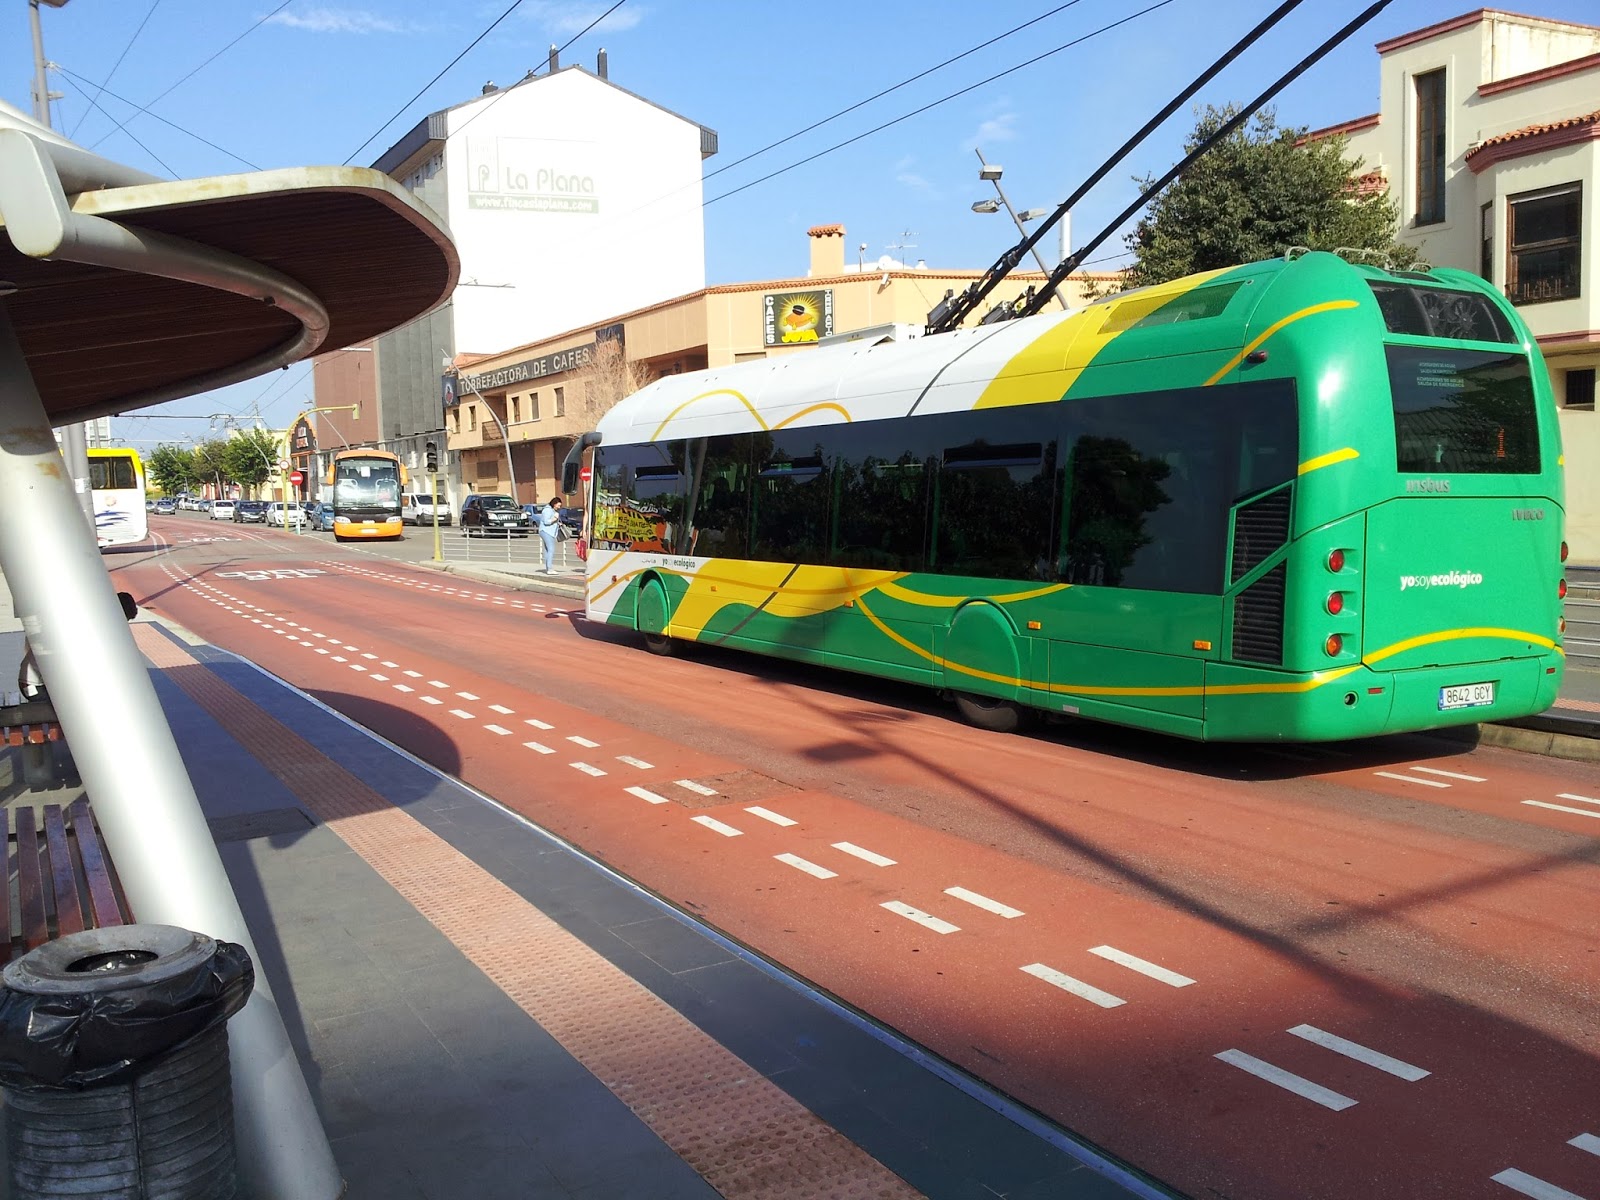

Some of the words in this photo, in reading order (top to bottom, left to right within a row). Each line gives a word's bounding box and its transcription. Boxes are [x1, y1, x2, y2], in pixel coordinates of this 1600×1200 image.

[506, 166, 529, 190] La
[537, 168, 594, 194] Plana
[765, 296, 775, 343] CAFES
[460, 365, 529, 393] TORREFACTORA
[533, 359, 547, 375] DE
[553, 348, 590, 370] CAFES
[1400, 570, 1483, 591] yosoyecológico
[1446, 688, 1470, 704] 8642
[1474, 685, 1491, 700] GCY
